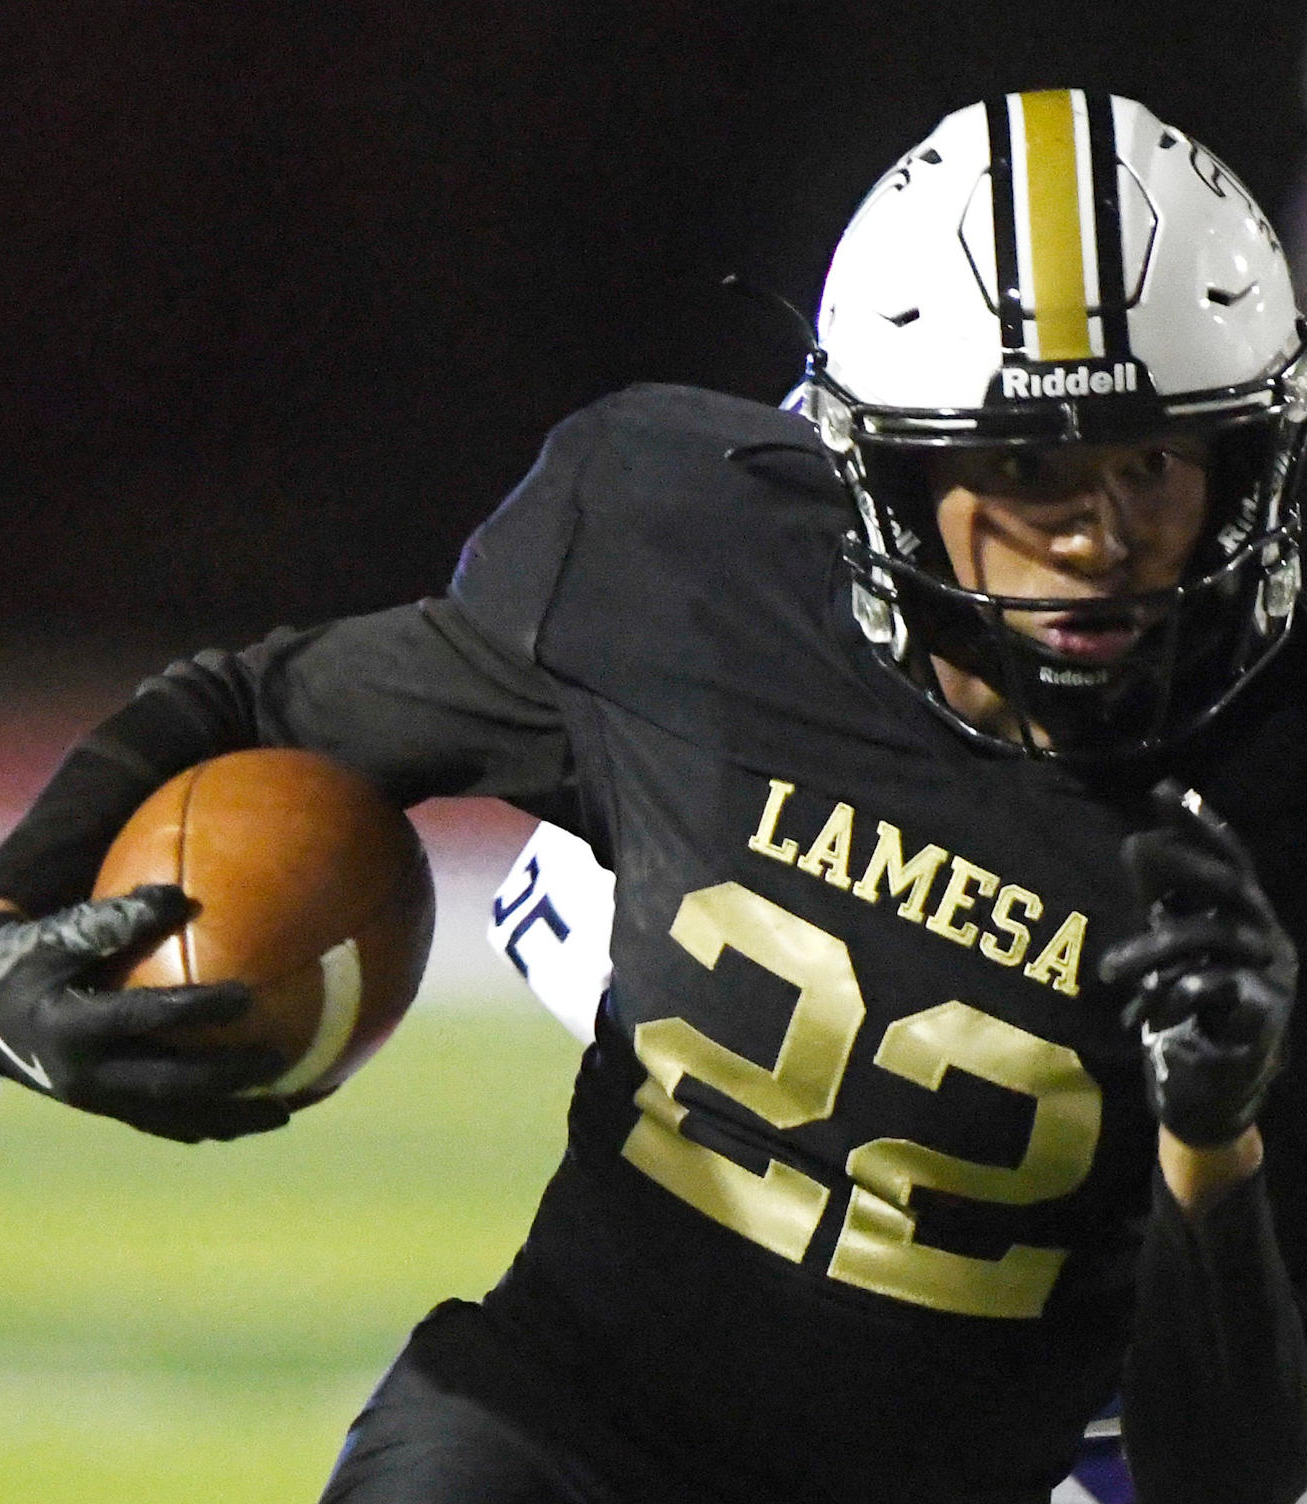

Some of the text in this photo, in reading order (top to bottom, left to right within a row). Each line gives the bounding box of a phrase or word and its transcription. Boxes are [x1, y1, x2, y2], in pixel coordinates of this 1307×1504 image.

[1002, 362, 1137, 398] Riddell
[748, 779, 1089, 997] LAMESA
[621, 881, 1103, 1319] 22
